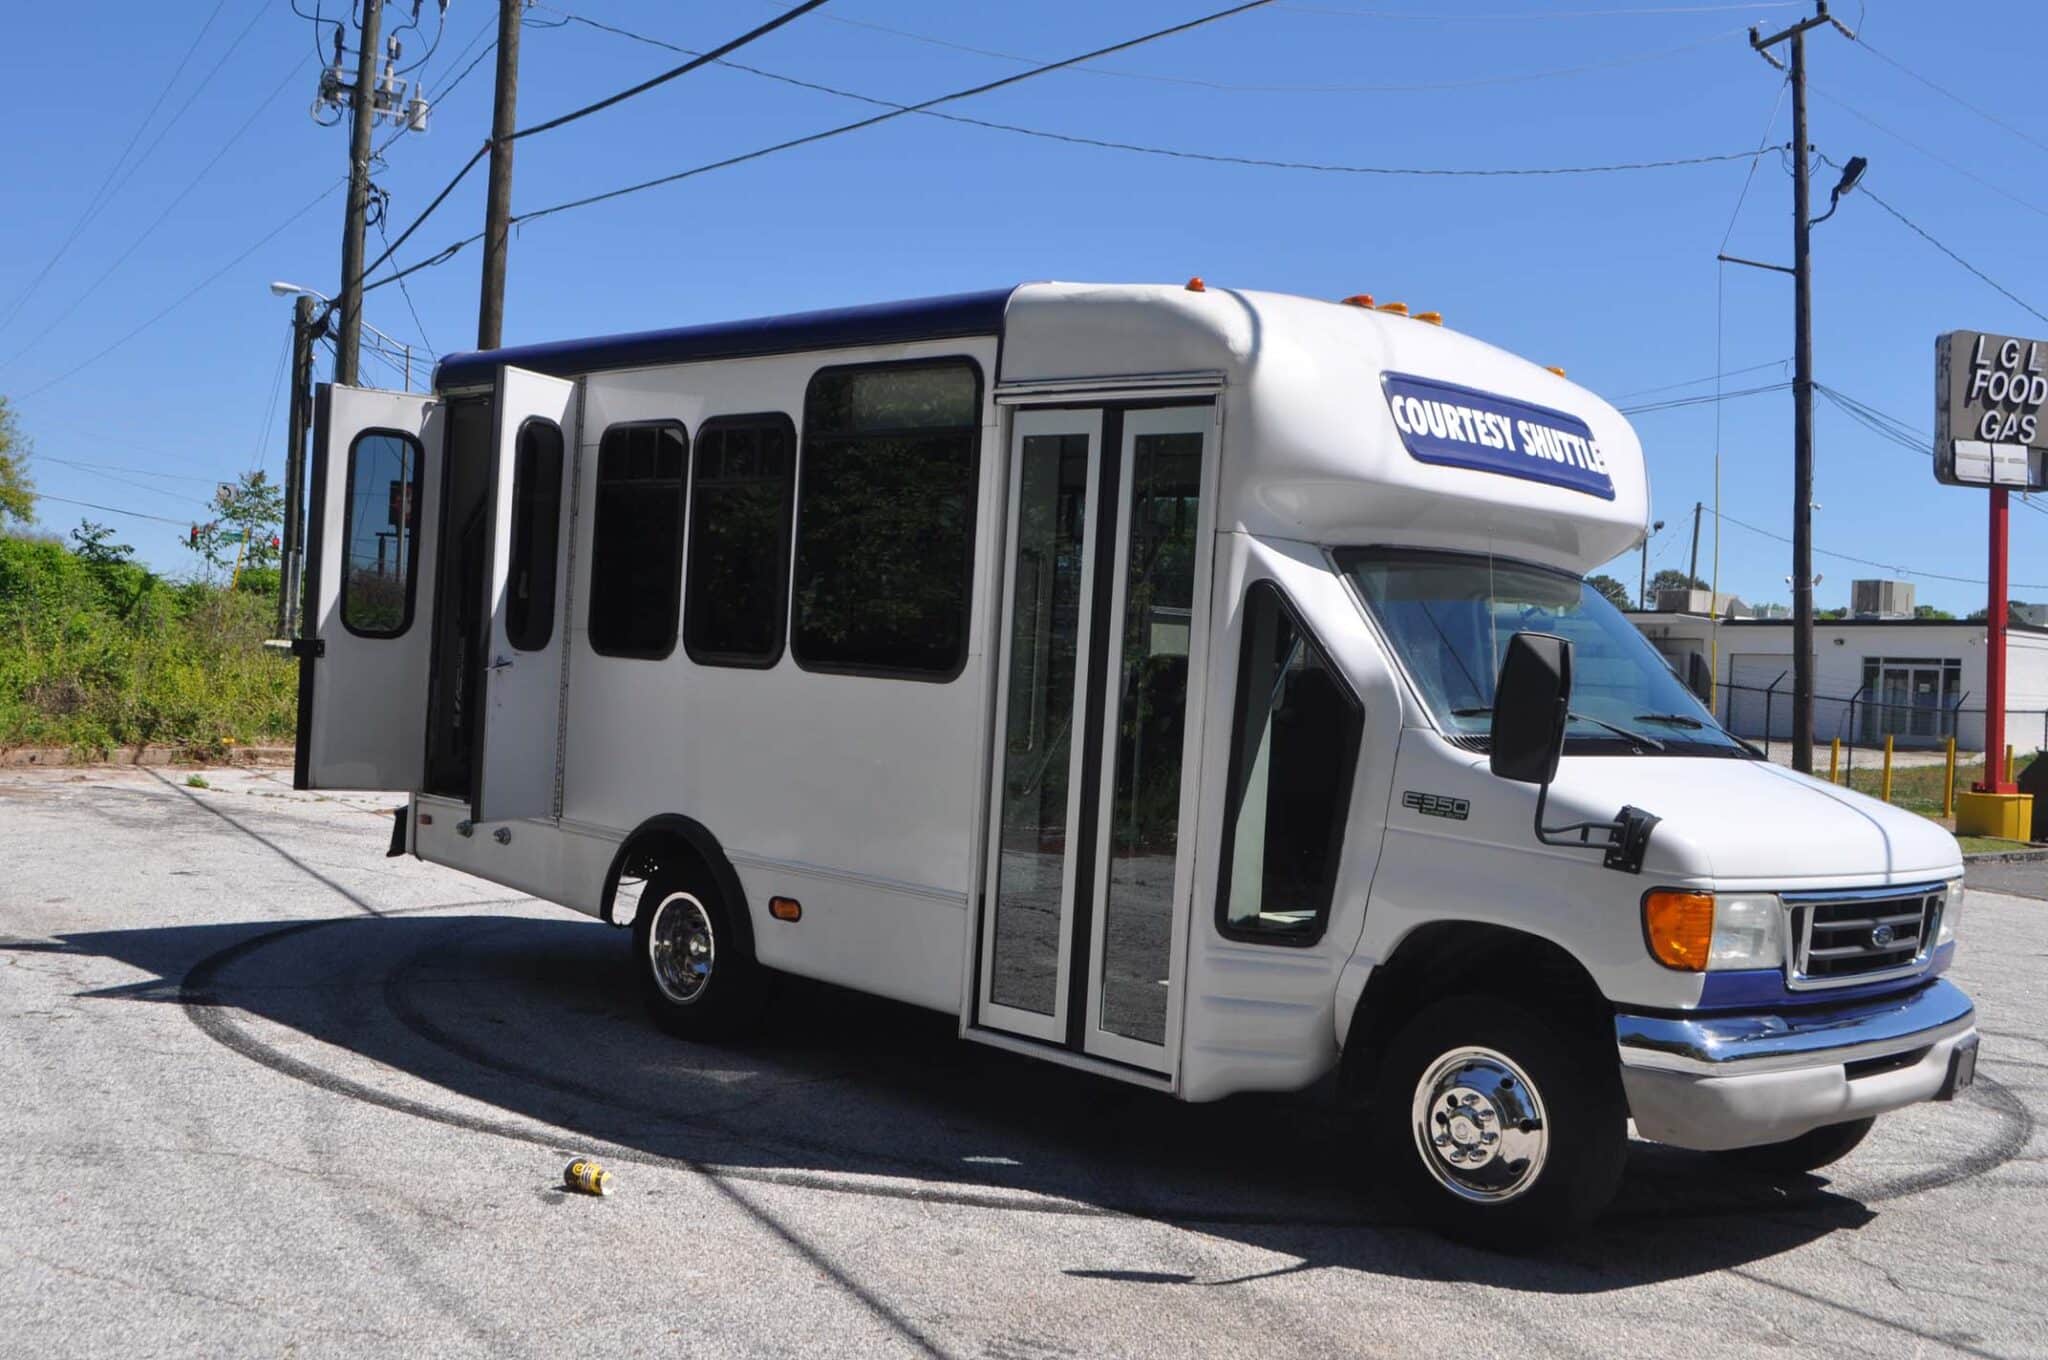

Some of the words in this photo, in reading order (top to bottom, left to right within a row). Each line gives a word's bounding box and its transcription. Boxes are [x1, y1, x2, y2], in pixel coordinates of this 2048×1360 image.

[1971, 369, 2047, 405] FOOD
[1392, 395, 1516, 451] COURTESY
[1517, 420, 1608, 475] SHUTTLE
[1981, 410, 2037, 443] GAS
